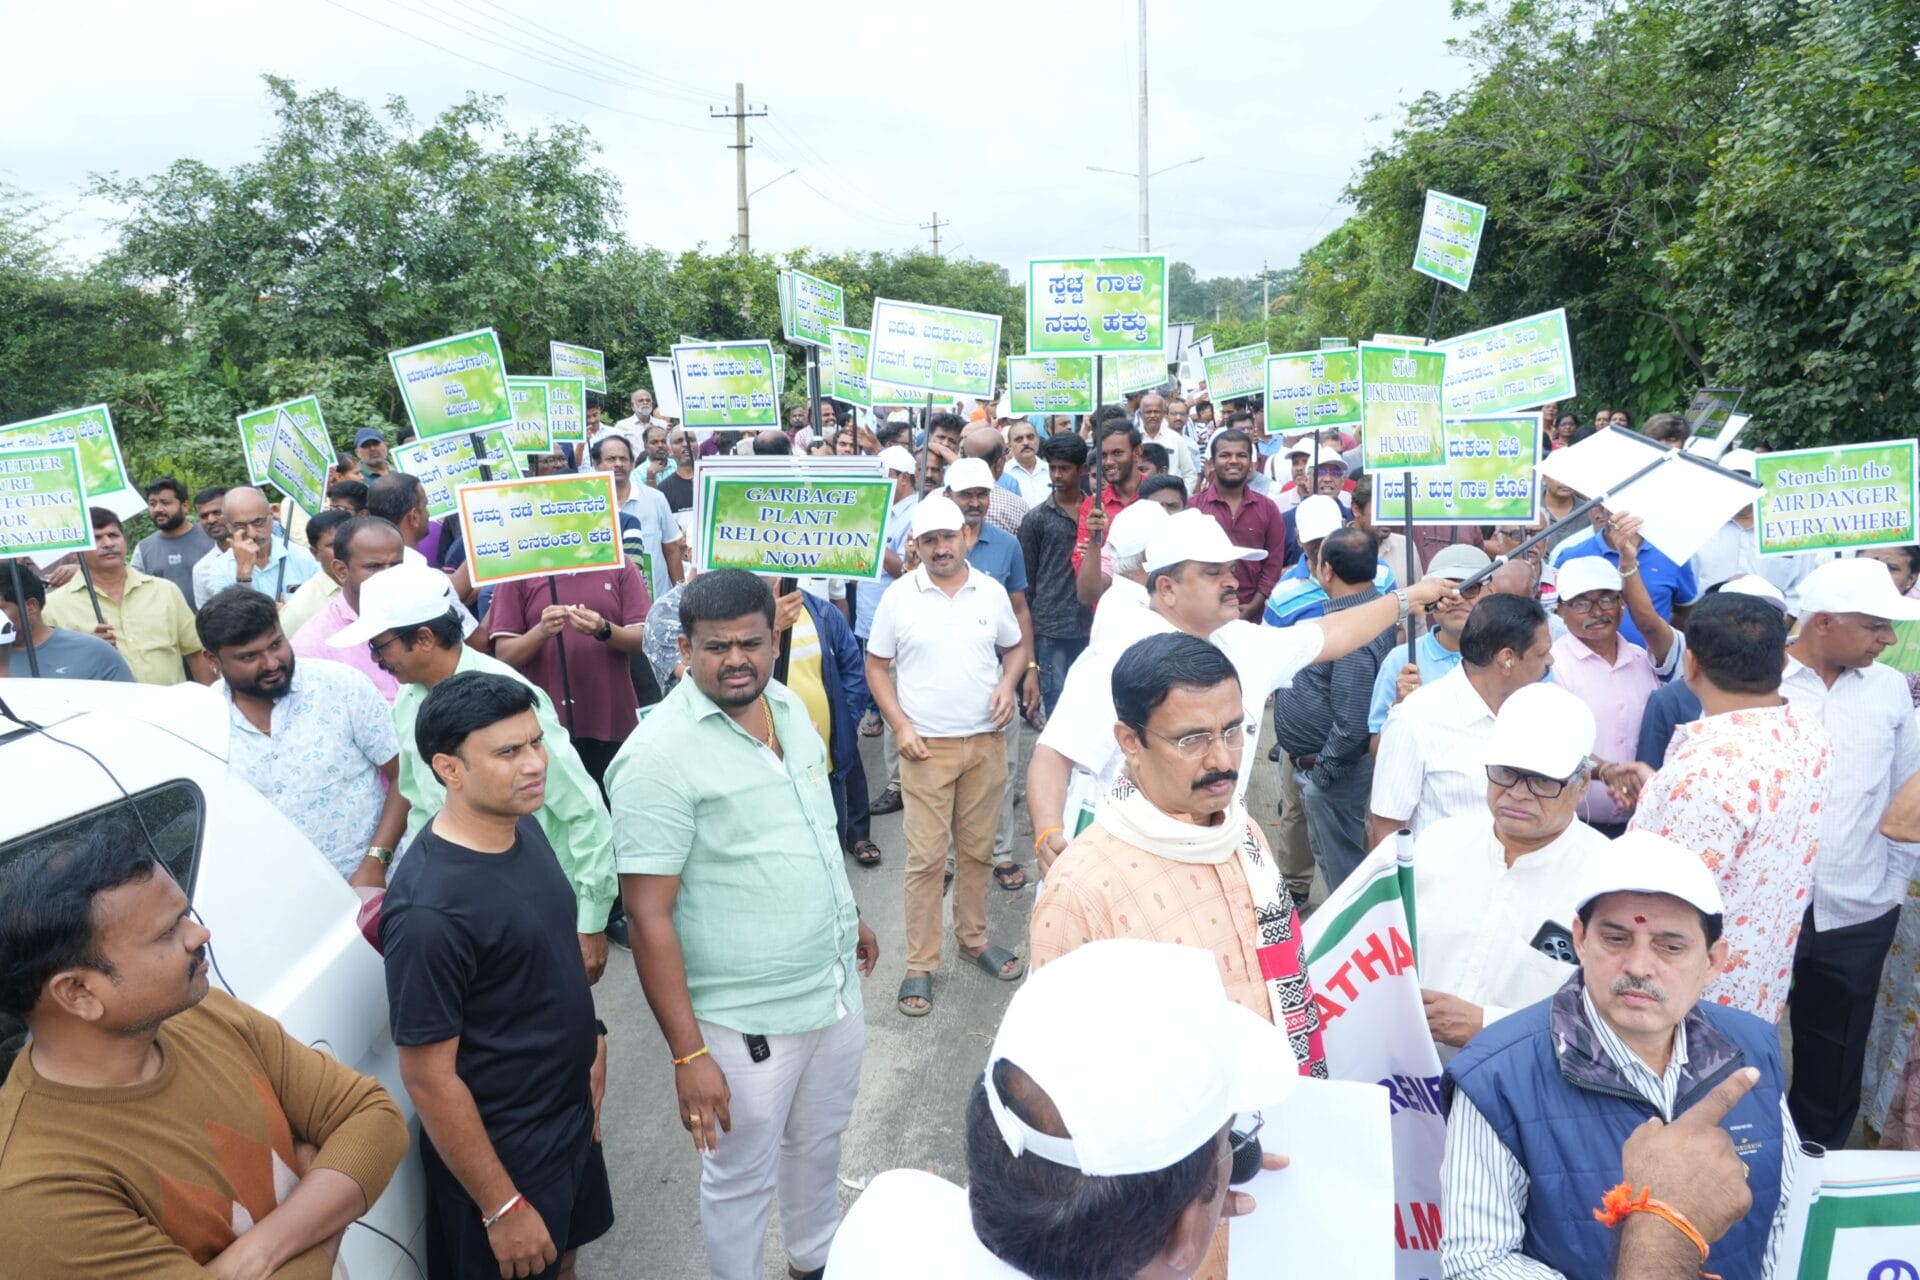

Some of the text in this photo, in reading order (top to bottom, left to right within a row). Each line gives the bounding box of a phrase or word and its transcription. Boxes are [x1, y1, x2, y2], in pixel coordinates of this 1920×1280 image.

[1096, 274, 1144, 293] ಗಾಳಿ
[1045, 310, 1148, 342] ನಮ್ಮ ಹಕ್ಕು
[1393, 358, 1417, 377] STOP
[1366, 383, 1440, 401] DISCRIMINATION
[1396, 410, 1418, 427] SAVE
[1380, 434, 1430, 453] HUMANISM
[1449, 437, 1520, 458] ದುಕಲು ಬಿಡಿ
[417, 465, 441, 485] ಮಗೆ
[1777, 460, 1890, 488] Stench in the
[746, 488, 857, 505] GARBAGE
[1460, 481, 1488, 498] ಗಾಳಿ
[1495, 476, 1528, 498] ಕೊಡಿ
[1772, 486, 1898, 513] AIR DANGER
[473, 496, 606, 526] ನಮ್ಮ ನಡೆ ದುರ್ವಾಸನೆ
[760, 507, 837, 525] PLANT
[1766, 510, 1907, 539] EVERY WHERE
[476, 528, 612, 558] ಮುಕ್ತ ಬನಶಂಕರಿ ಕಡೆ
[719, 526, 871, 547] RELOCATION
[765, 550, 822, 566] NOW
